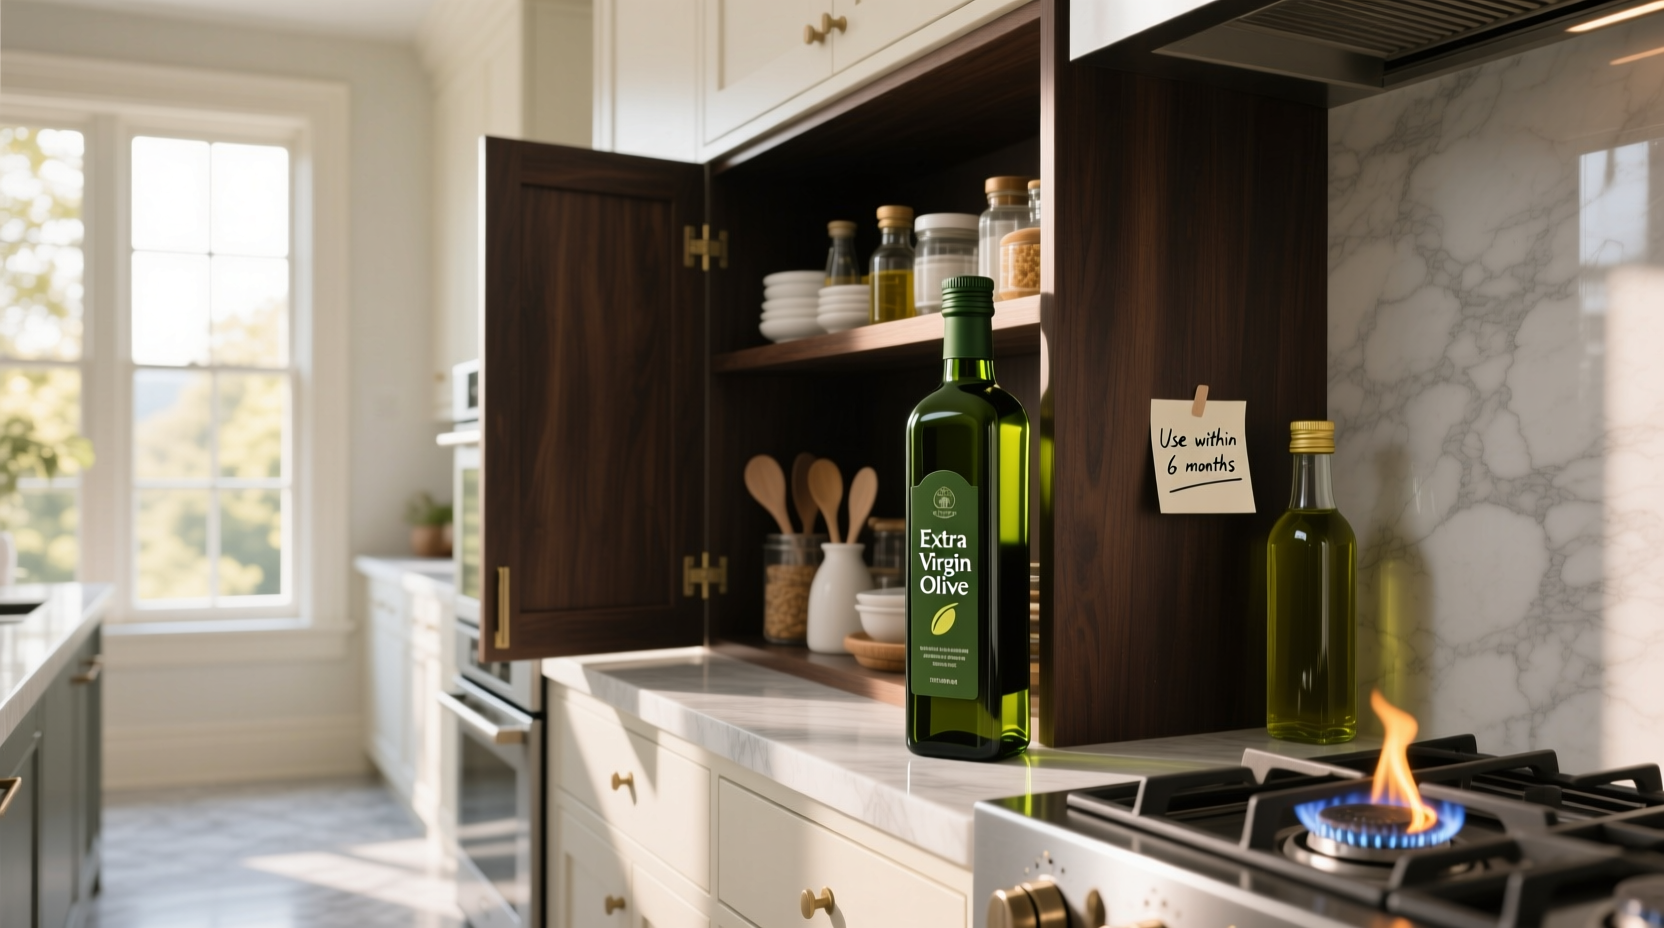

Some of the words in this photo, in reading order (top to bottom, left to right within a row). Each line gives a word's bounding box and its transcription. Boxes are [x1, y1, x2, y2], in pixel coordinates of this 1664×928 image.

[1159, 427, 1188, 449] Use
[1195, 427, 1237, 447] within
[1167, 454, 1178, 475] 6
[1185, 453, 1236, 473] months
[920, 528, 967, 549] Extra
[918, 552, 972, 577] Virgin
[919, 575, 969, 596] Olive
